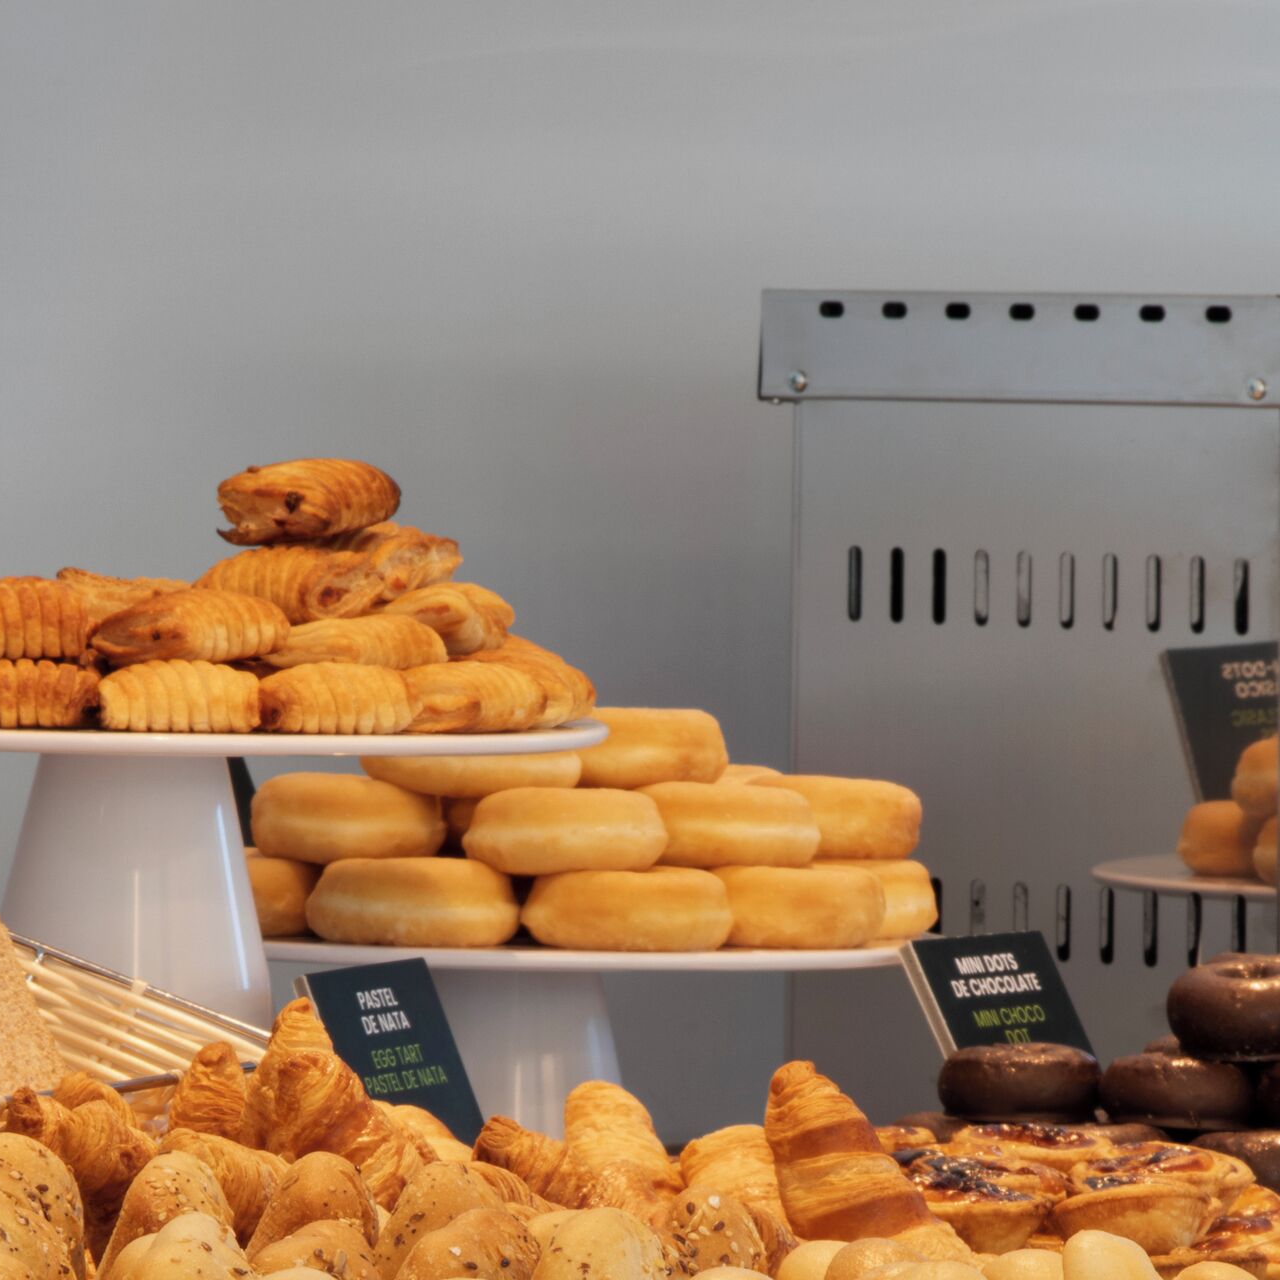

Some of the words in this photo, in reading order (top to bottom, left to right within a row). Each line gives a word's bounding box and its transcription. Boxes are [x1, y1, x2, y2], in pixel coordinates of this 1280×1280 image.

[954, 956, 984, 975] MINI
[985, 952, 1019, 972] DOTS
[951, 979, 970, 998] DE
[969, 972, 1042, 996] CHOCOLATE
[356, 987, 398, 1010] PASTEL
[361, 1015, 379, 1035] DE
[378, 1011, 411, 1033] NATA
[973, 1010, 1001, 1028] MINI
[999, 1004, 1045, 1026] CHOCO
[1005, 1028, 1031, 1045] DOT
[371, 1048, 396, 1070] EGG
[396, 1044, 424, 1064] TART
[364, 1073, 403, 1095] PASTEL
[403, 1070, 421, 1089] DE
[420, 1065, 448, 1086] NATA
